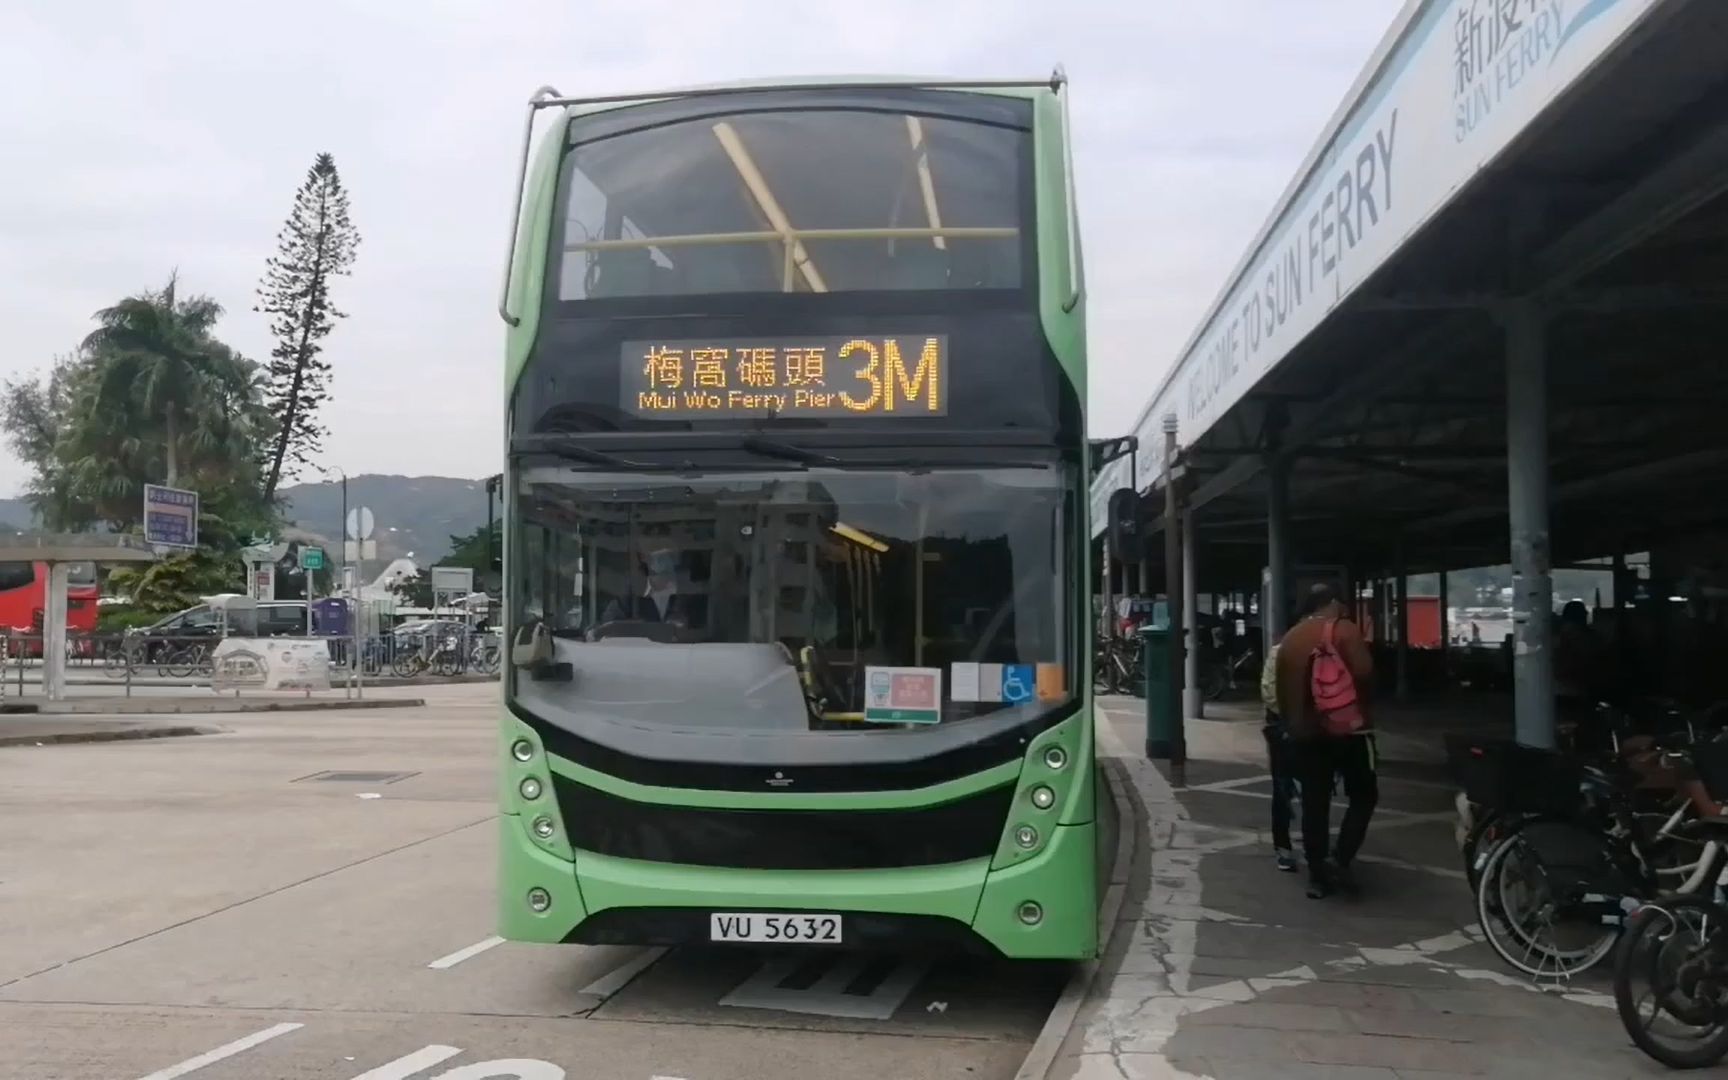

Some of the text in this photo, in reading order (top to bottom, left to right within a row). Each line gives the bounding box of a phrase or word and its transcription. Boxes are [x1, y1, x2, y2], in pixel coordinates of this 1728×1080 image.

[1454, 0, 1536, 99] 新渡
[1456, 0, 1564, 143] SUN FERRY
[1243, 290, 1262, 362] TO
[1264, 245, 1303, 338] SUN
[1308, 107, 1398, 294] FERRY
[638, 389, 835, 412] Mui Wo Ferry Pier
[643, 345, 827, 389] 梅窩碼頭
[838, 338, 939, 411] 3M
[717, 916, 837, 940] VU 5632
